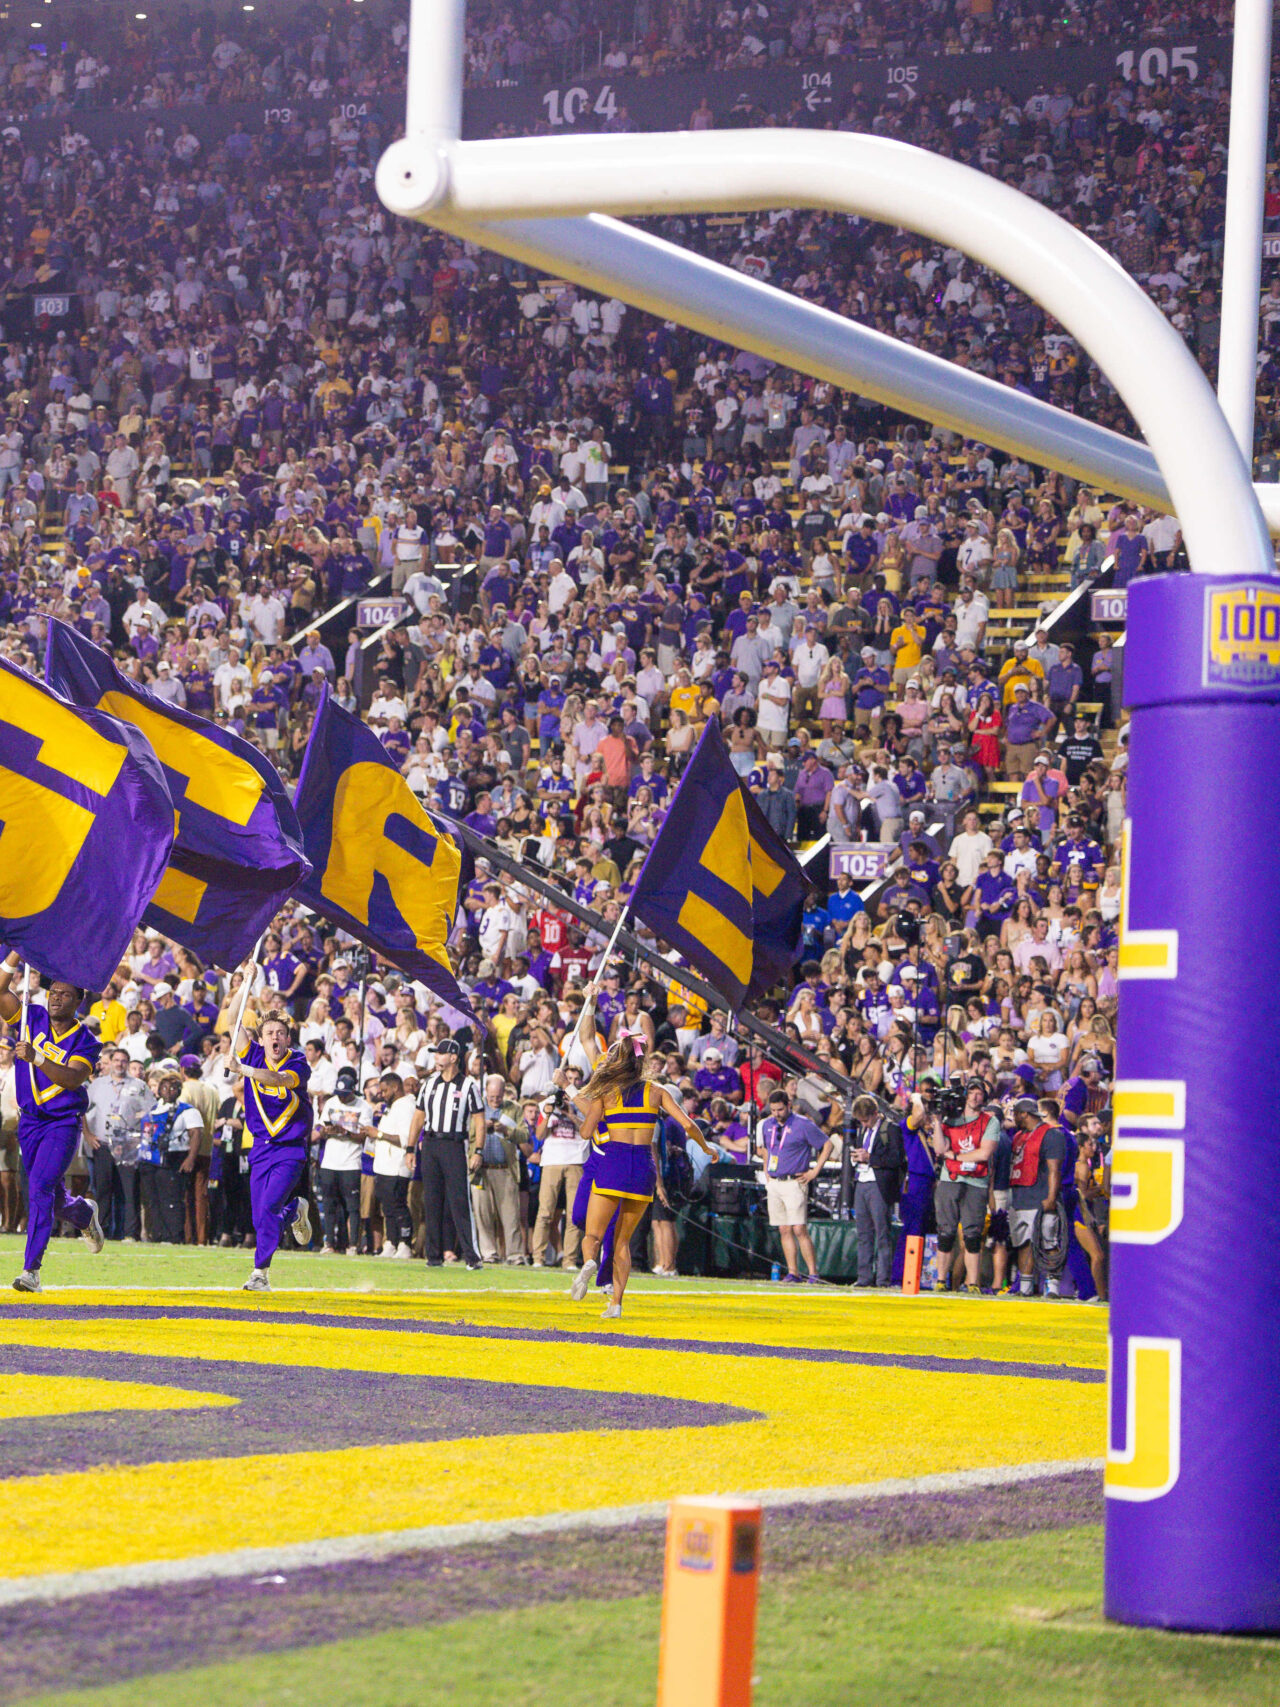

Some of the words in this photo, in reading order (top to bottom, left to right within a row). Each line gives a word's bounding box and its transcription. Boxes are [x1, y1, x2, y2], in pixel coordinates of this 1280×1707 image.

[887, 66, 918, 84] 105
[1116, 45, 1199, 86] 105
[802, 72, 832, 90] 104
[340, 103, 368, 119] 104
[543, 85, 618, 125] 104
[40, 300, 64, 314] 103
[966, 549, 974, 566] 7
[363, 607, 395, 626] 104
[1100, 599, 1128, 618] 10
[1219, 604, 1280, 642] 100
[320, 761, 463, 974] R
[839, 855, 879, 875] 105
[543, 923, 561, 944] 10
[32, 1031, 68, 1066] LSU
